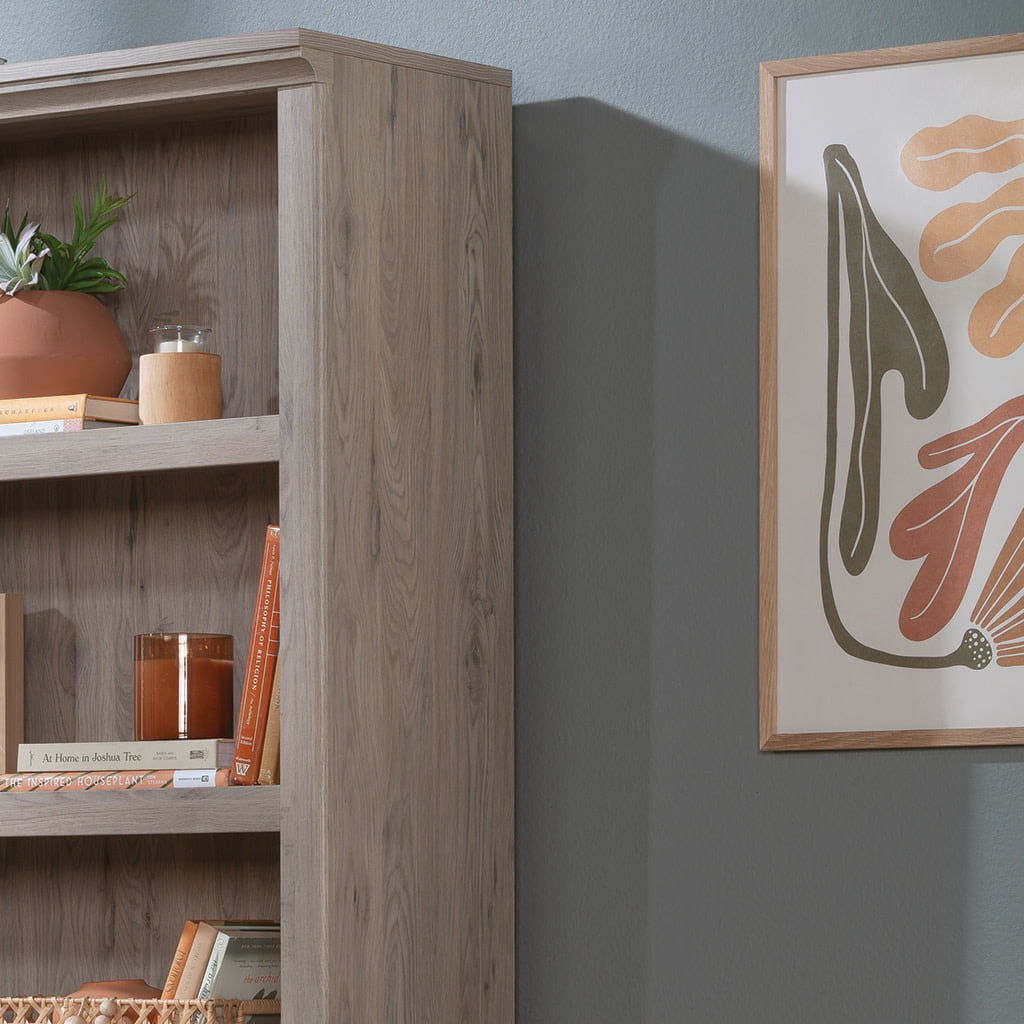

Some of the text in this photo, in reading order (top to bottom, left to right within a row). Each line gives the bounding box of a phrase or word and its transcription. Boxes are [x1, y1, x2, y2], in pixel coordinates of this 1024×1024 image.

[252, 579, 272, 690] PHILOSOPHY OF RELIGION
[42, 751, 142, 764] At Home in Joshua Tree
[5, 774, 143, 788] THE INSPIRED HOUSEPLANT
